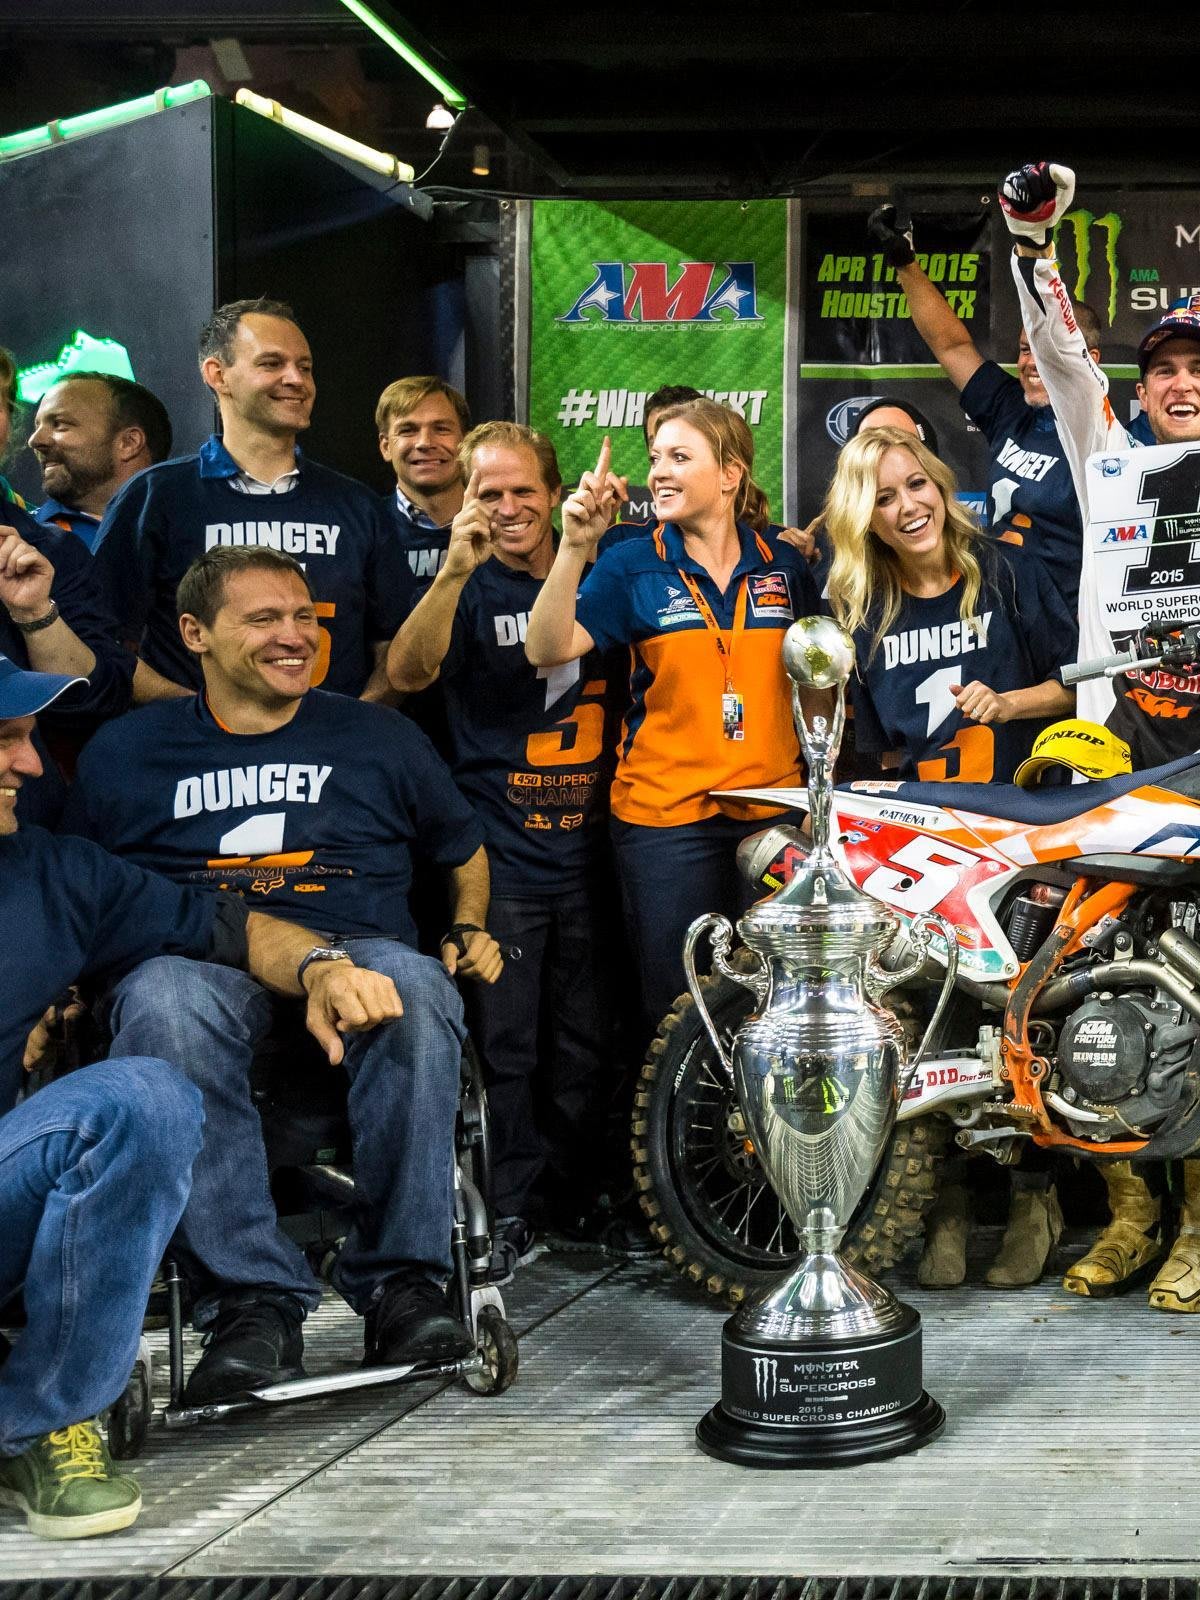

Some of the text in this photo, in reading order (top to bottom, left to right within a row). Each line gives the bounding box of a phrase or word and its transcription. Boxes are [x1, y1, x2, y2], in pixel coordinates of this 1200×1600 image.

[1129, 269, 1159, 282] AMA
[554, 262, 765, 321] AMA
[821, 290, 913, 318] HOUSTO
[553, 321, 766, 332] AMERICAN MOTORCYCLIST ASSOCIATION
[1101, 524, 1149, 544] AMA
[1150, 569, 1185, 585] 2015
[1106, 600, 1153, 613] WORLD
[883, 611, 992, 671] DUNGEY
[915, 665, 963, 738] 1
[1034, 729, 1105, 757] DUNLOP
[515, 774, 541, 786] 450
[174, 764, 332, 819] DUNGEY
[525, 820, 552, 830] Red Bull
[889, 811, 926, 826] ATHENA
[861, 833, 982, 914] 5
[1078, 1020, 1114, 1035] KTM
[1073, 1034, 1118, 1044] FACTORY
[804, 1372, 850, 1381] ENERGY
[779, 1377, 876, 1394] SUPERCROSS
[761, 1412, 844, 1423] SUPERCROSS
[846, 1400, 901, 1419] CHAMPION
[798, 1405, 824, 1414] 2015
